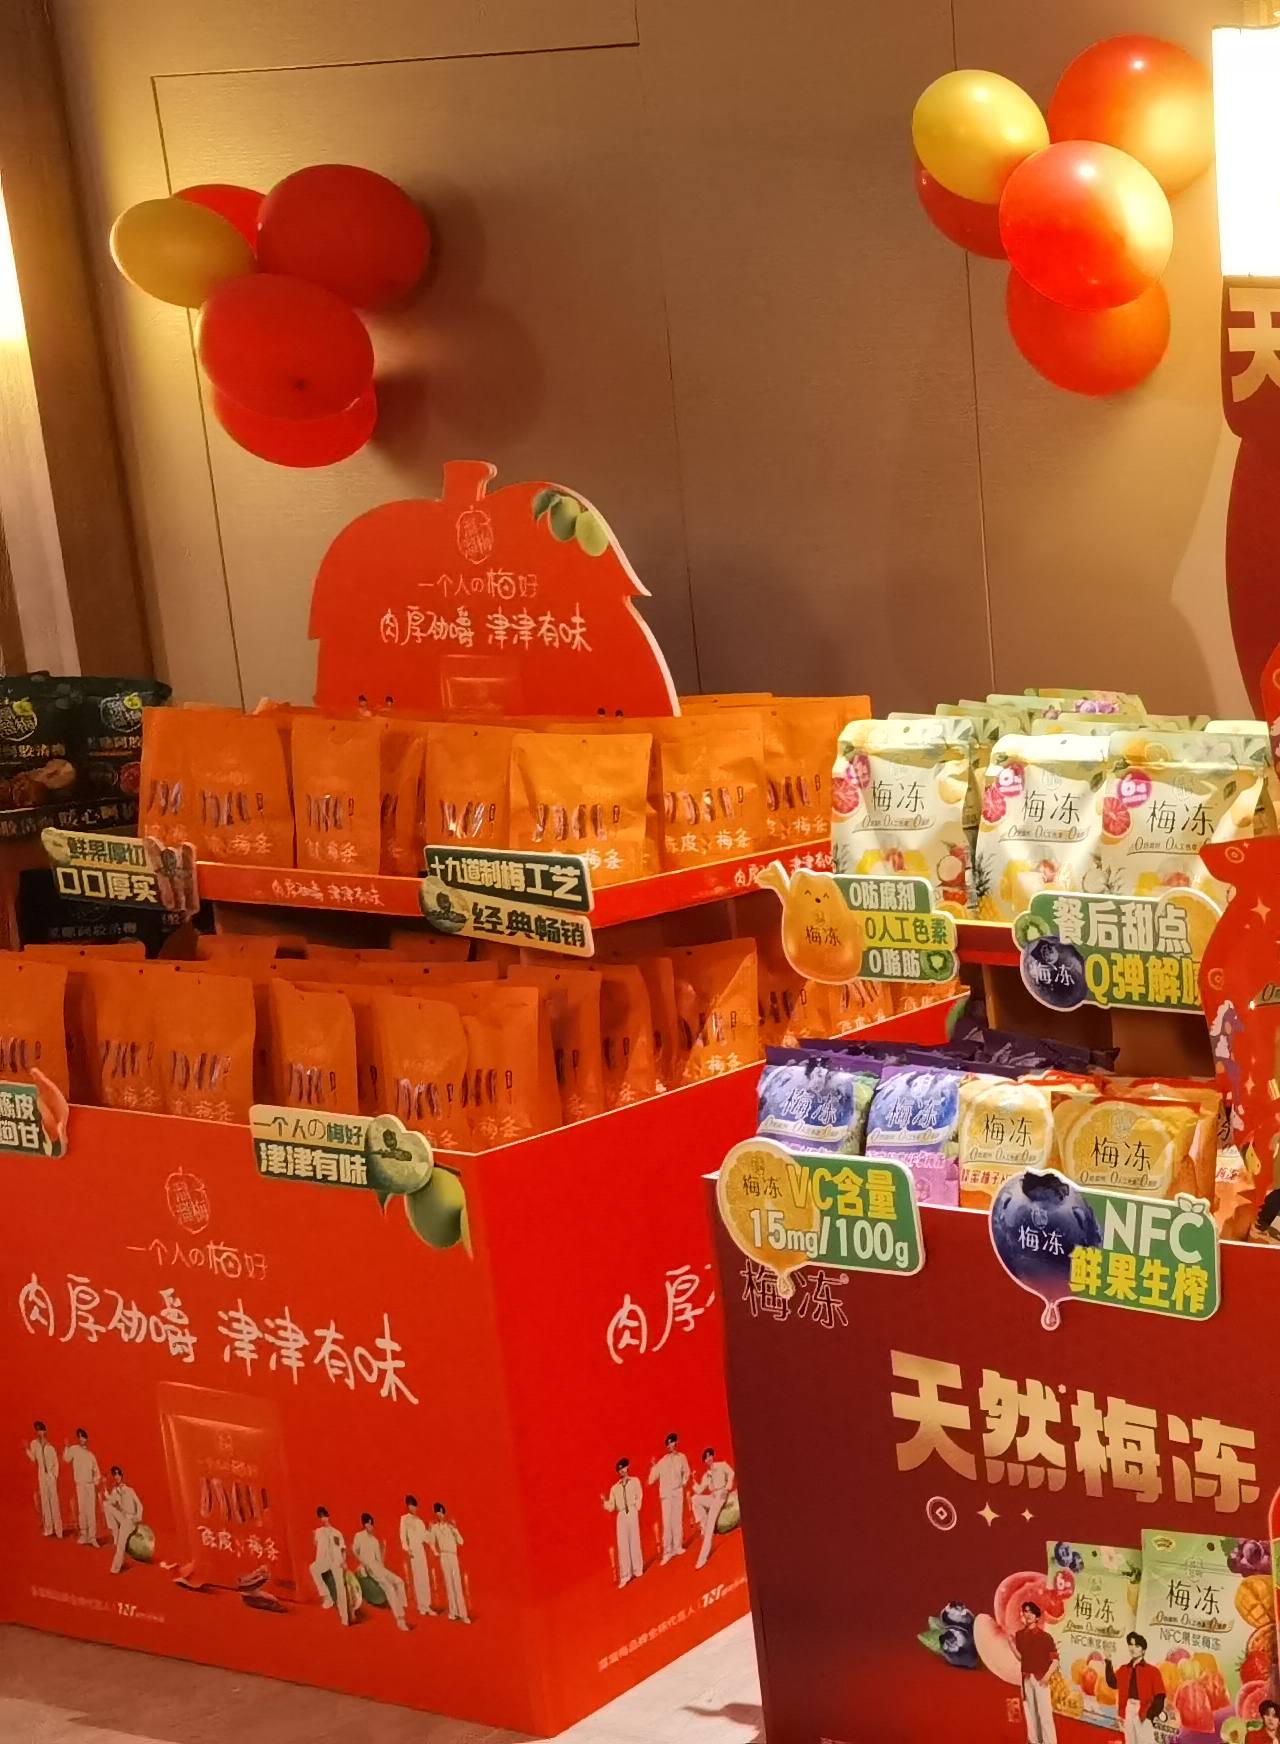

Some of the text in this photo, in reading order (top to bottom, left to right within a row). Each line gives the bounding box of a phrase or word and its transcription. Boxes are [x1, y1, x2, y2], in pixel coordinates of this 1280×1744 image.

[486, 601, 593, 653] 津津有味
[870, 780, 926, 813] 梅冻
[1021, 789, 1081, 825] 梅冻
[1146, 800, 1215, 836] 梅冻
[430, 855, 583, 903] 十九道制梅工艺
[849, 881, 917, 912] 0防腐剂
[470, 900, 586, 948] 经典畅销
[864, 916, 949, 946] 0人工色素
[1052, 898, 1193, 956] 餐后甜点
[868, 950, 922, 978] 0脂肪
[1029, 962, 1075, 988] 梅冻
[982, 1112, 1033, 1149] 梅冻
[259, 1143, 368, 1186] 津津有味
[1090, 1135, 1151, 1172] 梅冻
[785, 1162, 897, 1221] VC含量
[749, 1207, 909, 1269] 15mg/100g
[1018, 1225, 1066, 1255] 梅冻
[1103, 1198, 1204, 1263] NFC
[741, 1258, 849, 1329] 梅冻
[1069, 1246, 1210, 1313] 鲜果生榨
[217, 1298, 419, 1405] 津津有味
[889, 1349, 1261, 1514] 天然梅冻
[1074, 1594, 1116, 1625] 梅冻
[1167, 1579, 1221, 1616] 梅冻
